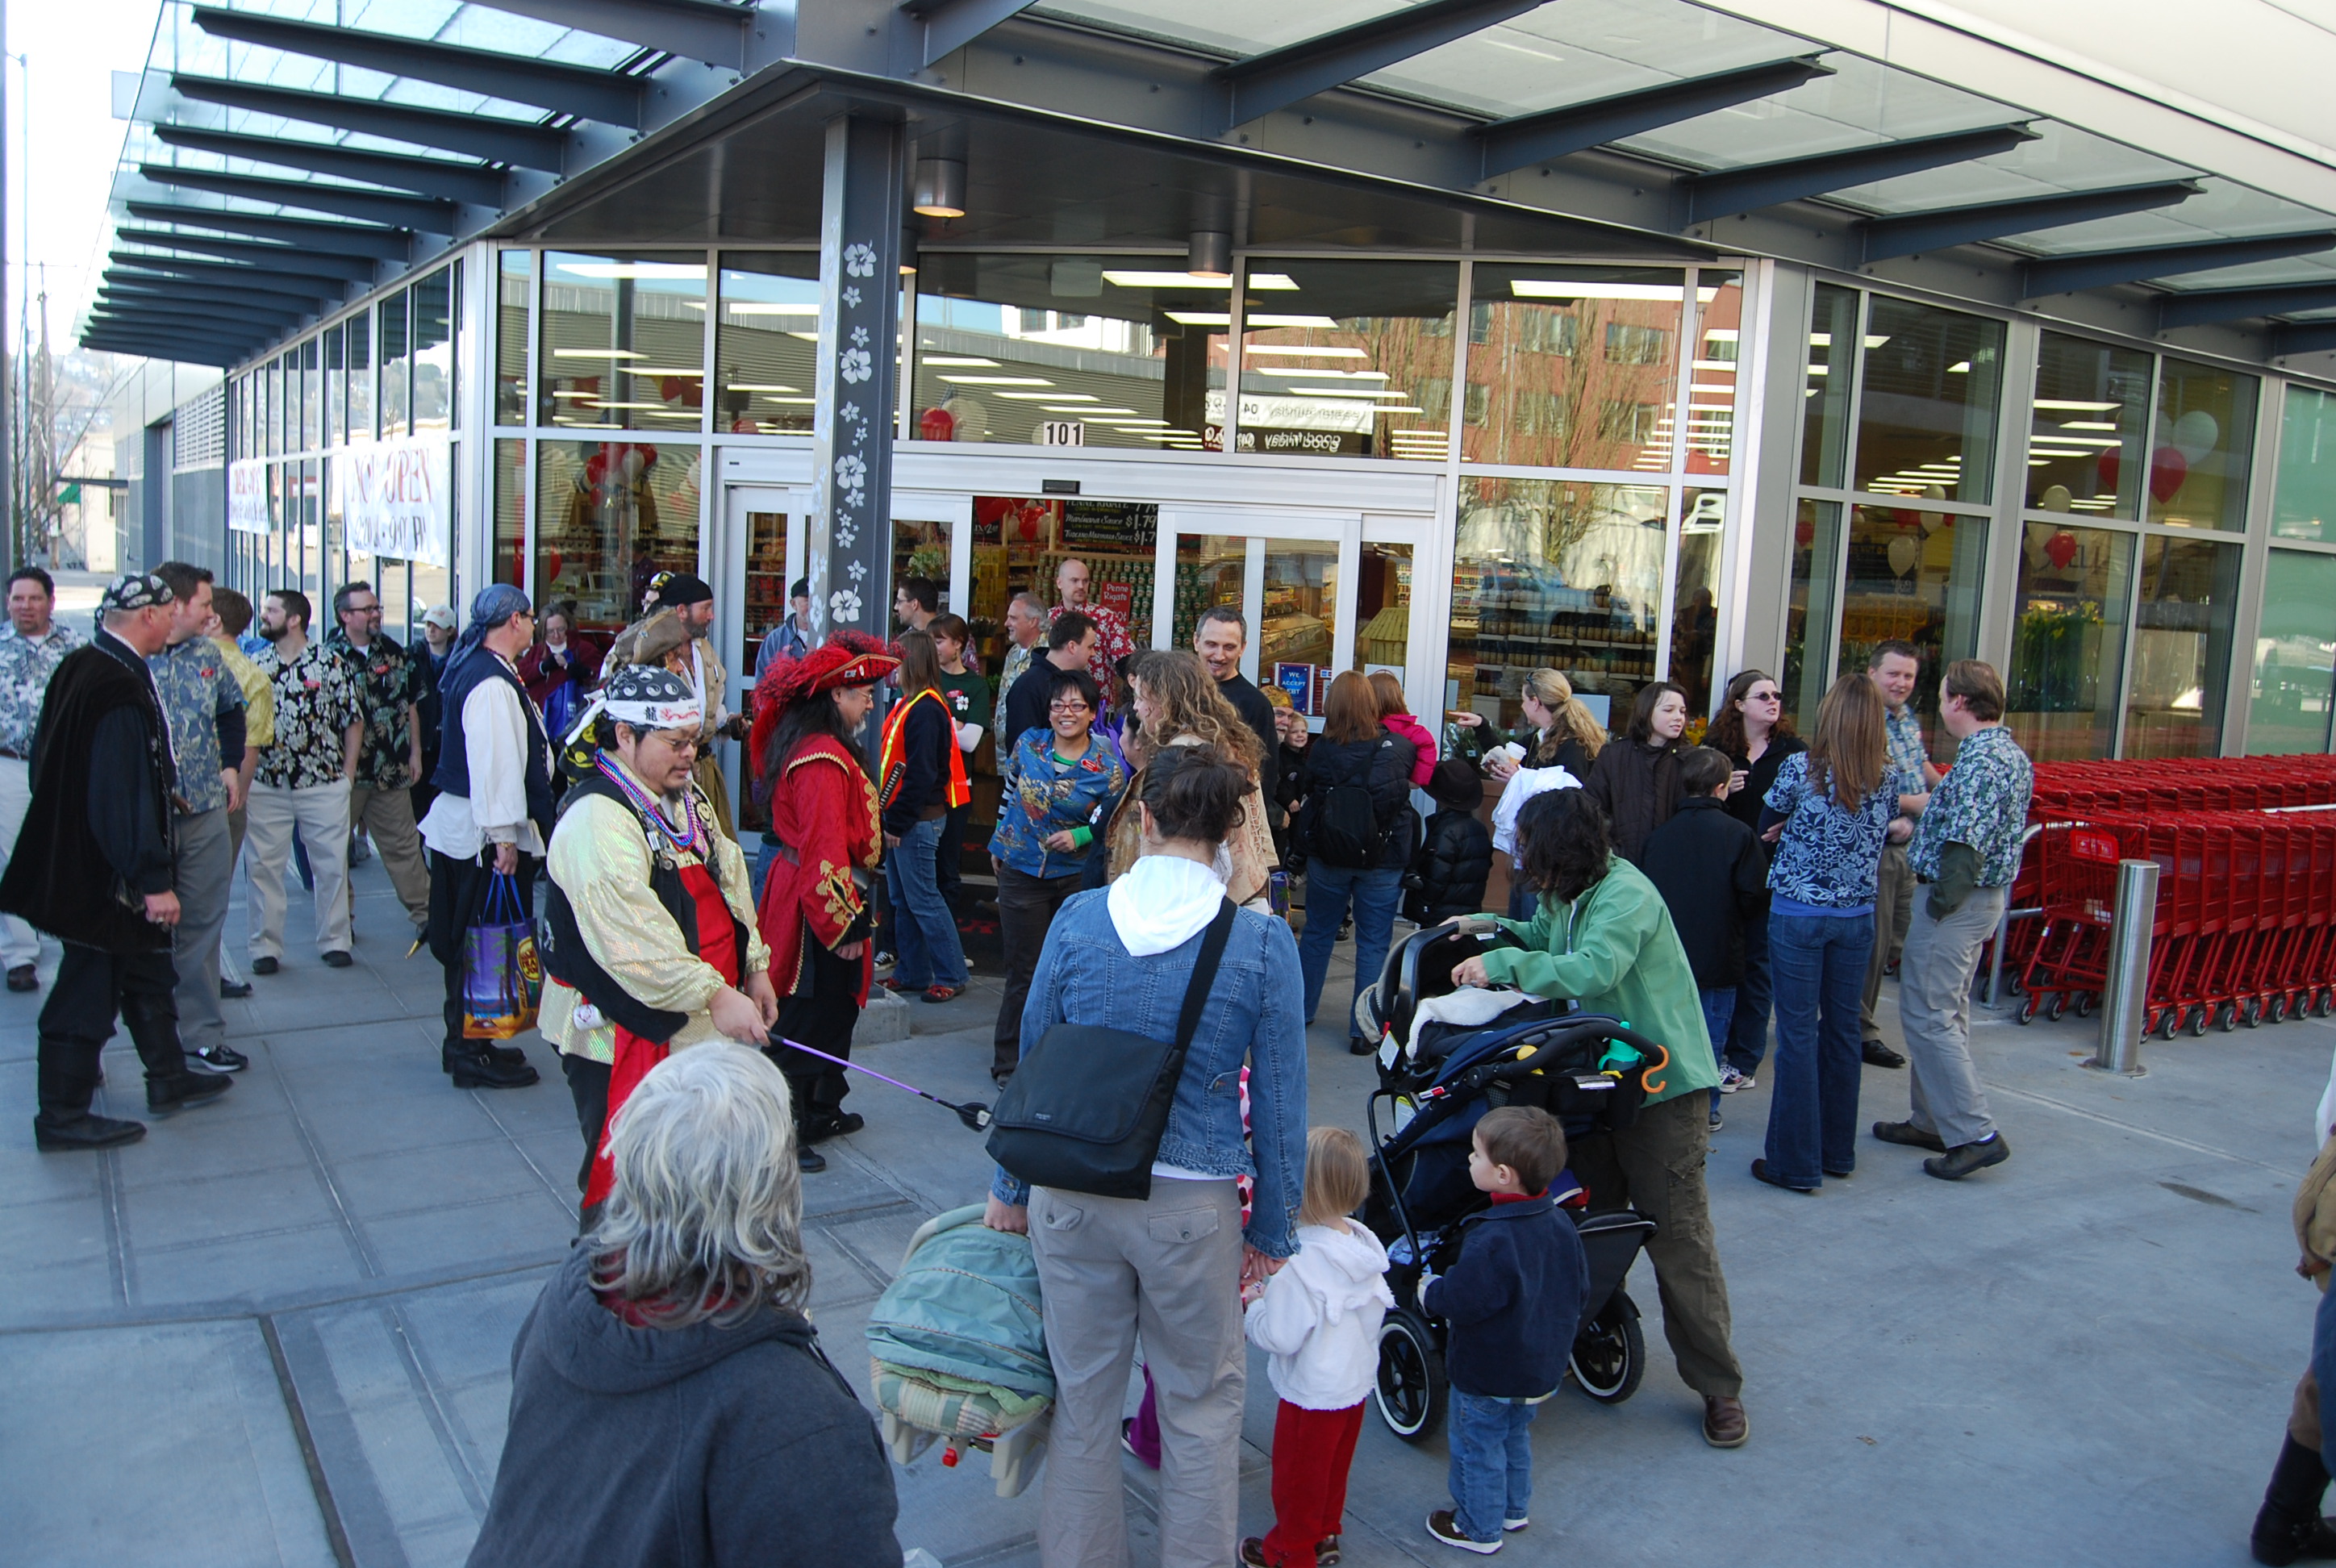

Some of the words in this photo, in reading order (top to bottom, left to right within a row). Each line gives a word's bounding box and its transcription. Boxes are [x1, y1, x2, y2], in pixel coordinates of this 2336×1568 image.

[1047, 423, 1080, 445] 101
[1125, 514, 1158, 530] $1.79
[1107, 583, 1128, 592] Penne
[1103, 591, 1128, 603] Rigate
